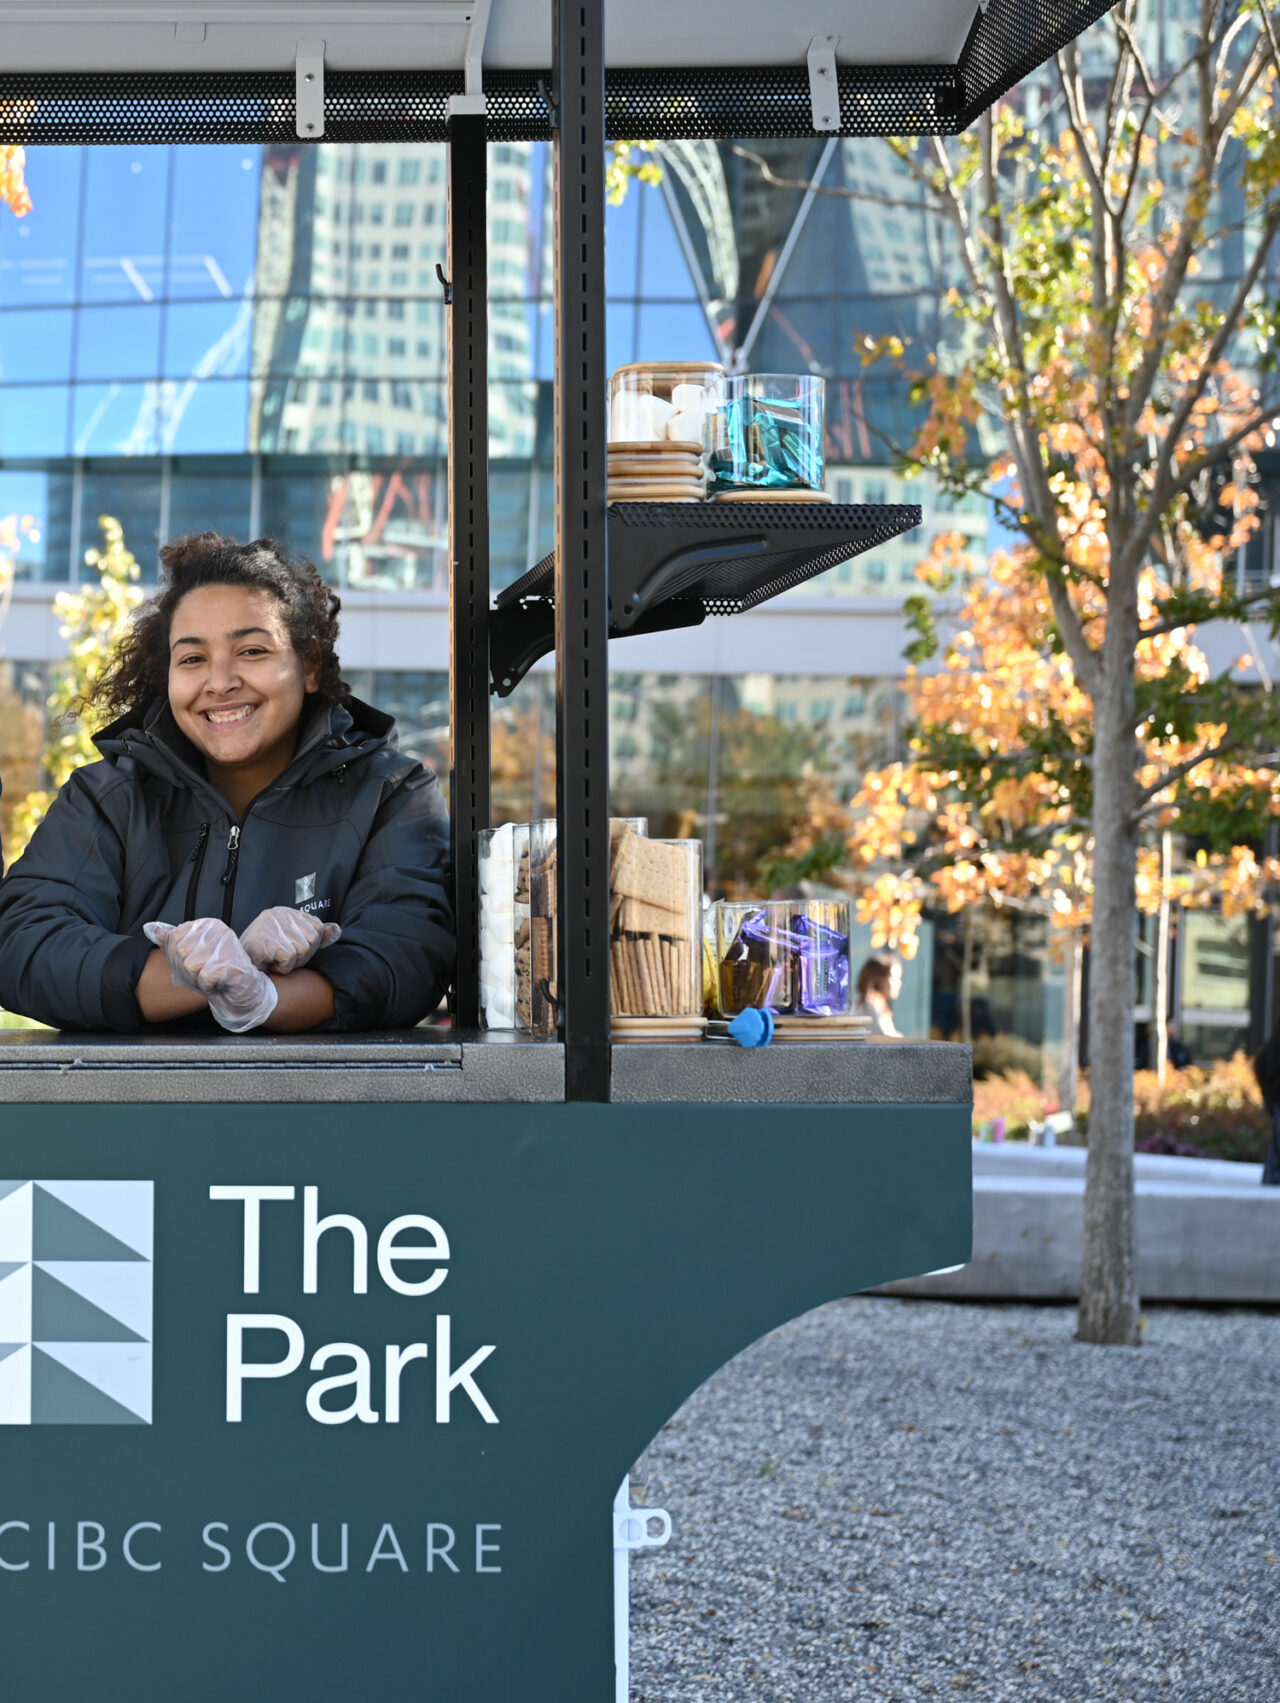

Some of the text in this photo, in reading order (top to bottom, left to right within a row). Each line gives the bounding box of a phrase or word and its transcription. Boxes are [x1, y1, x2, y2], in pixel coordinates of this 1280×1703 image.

[209, 1186, 450, 1296] The
[226, 1314, 499, 1424] Park
[203, 1522, 501, 1582] SQUARE
